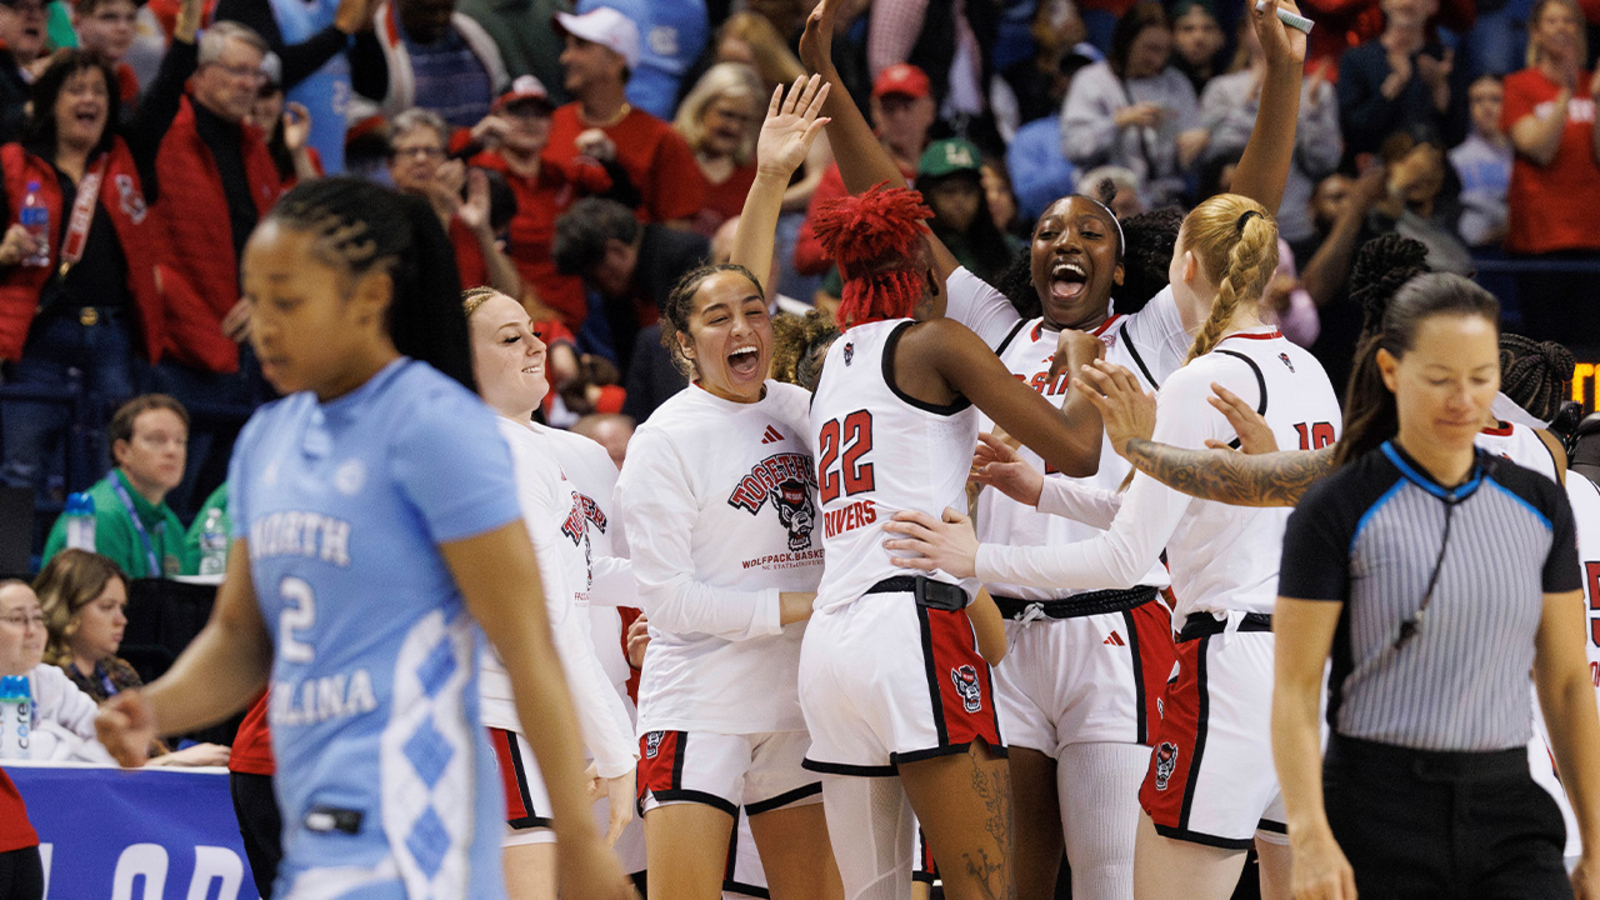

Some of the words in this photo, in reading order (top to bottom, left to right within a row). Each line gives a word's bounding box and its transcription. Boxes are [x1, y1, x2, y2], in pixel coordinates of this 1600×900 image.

[727, 452, 819, 516] TOGETHE
[819, 408, 875, 506] 22
[824, 500, 877, 540] RIVERS
[278, 576, 316, 664] 2
[16, 701, 30, 750] core
